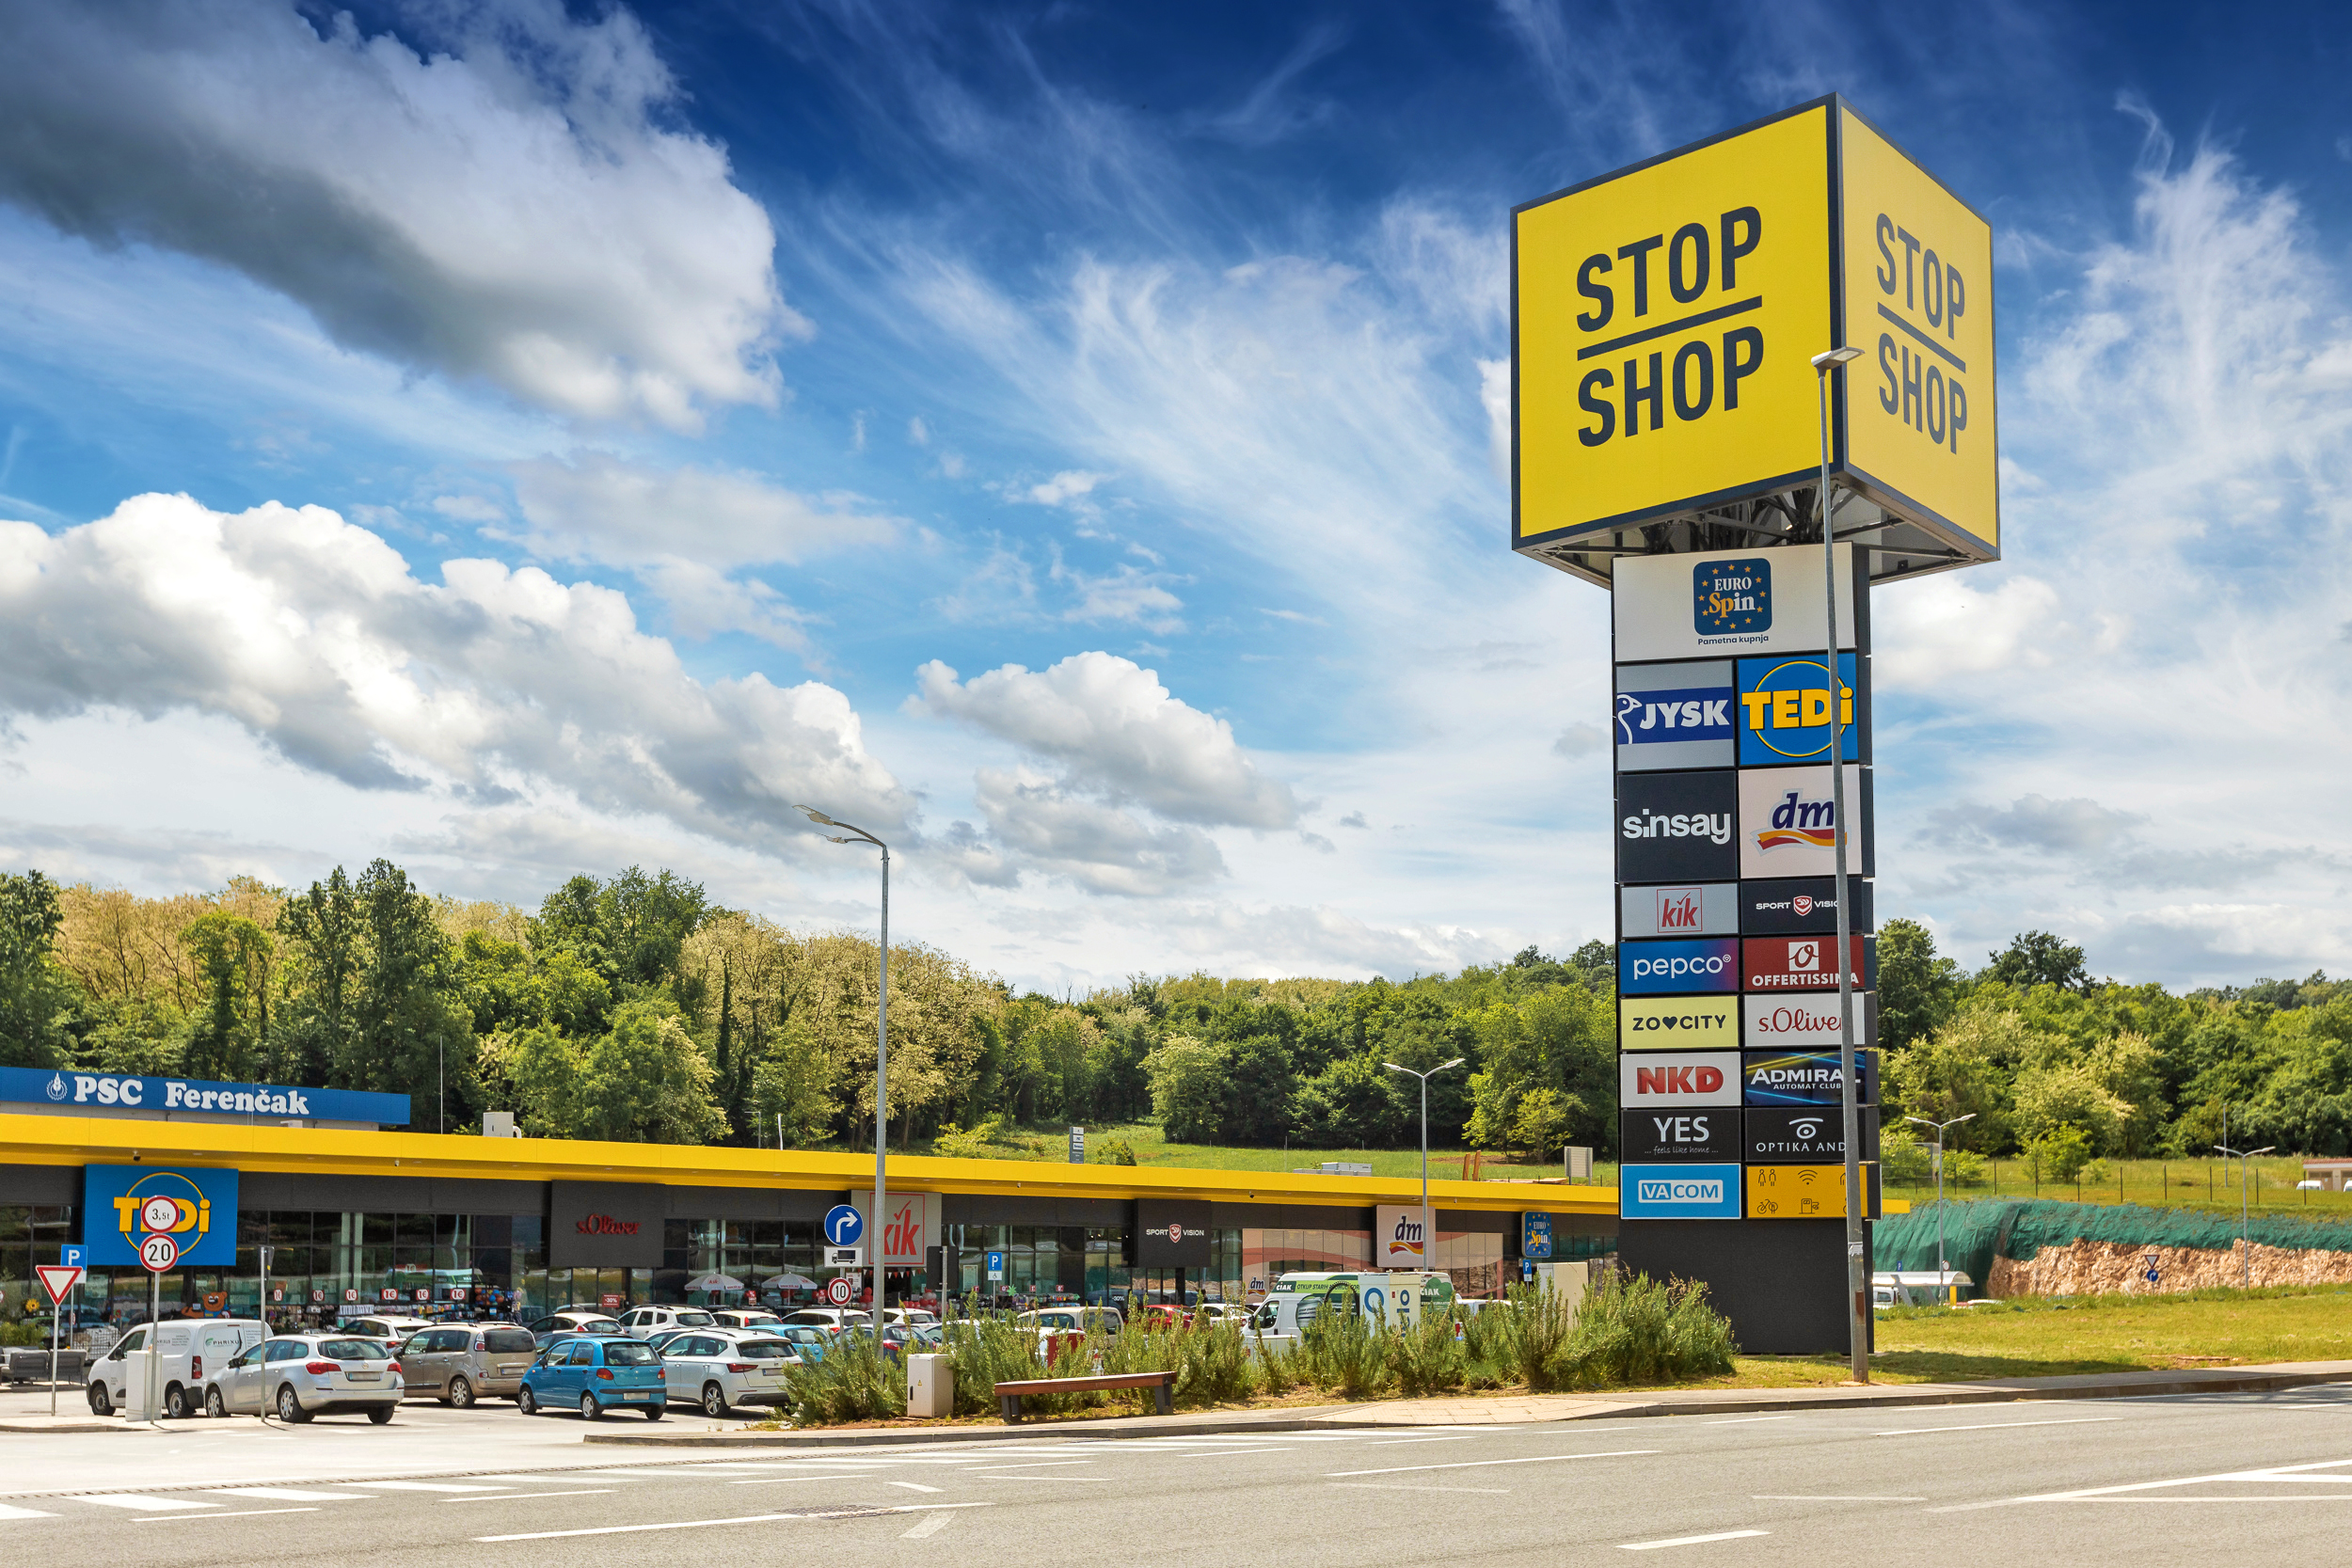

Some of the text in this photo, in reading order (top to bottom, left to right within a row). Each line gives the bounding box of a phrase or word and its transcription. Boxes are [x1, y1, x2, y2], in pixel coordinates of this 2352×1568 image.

[1577, 206, 1761, 332] STOP
[1876, 213, 1965, 340] STOP
[1578, 325, 1764, 448] SHOP
[1879, 332, 1967, 454] SHOP
[1714, 577, 1752, 592] EURO
[1708, 592, 1756, 618] Spin
[1698, 634, 1769, 645] Pametna kupnja
[1639, 699, 1730, 730] JYSK
[1741, 687, 1854, 731] TEDi
[1772, 792, 1835, 830] dm
[1623, 808, 1731, 845] sinsay
[1661, 892, 1698, 927] kik
[1756, 902, 1791, 911] SPORT
[1633, 956, 1724, 980] pepco
[1637, 1066, 1724, 1094] NKD
[73, 1075, 310, 1115] PSC Ferenčak
[1653, 1117, 1709, 1142] YES
[1756, 1143, 1810, 1152] OPTIKA
[577, 1213, 642, 1234] s.Oliver
[1395, 1215, 1422, 1241] dm
[1532, 1230, 1548, 1247] Spin
[69, 1250, 80, 1265] P
[148, 1243, 171, 1261] 20
[992, 1256, 998, 1267] P
[1525, 1262, 1530, 1272] P
[835, 1286, 847, 1298] 10
[1250, 1277, 1263, 1289] dm
